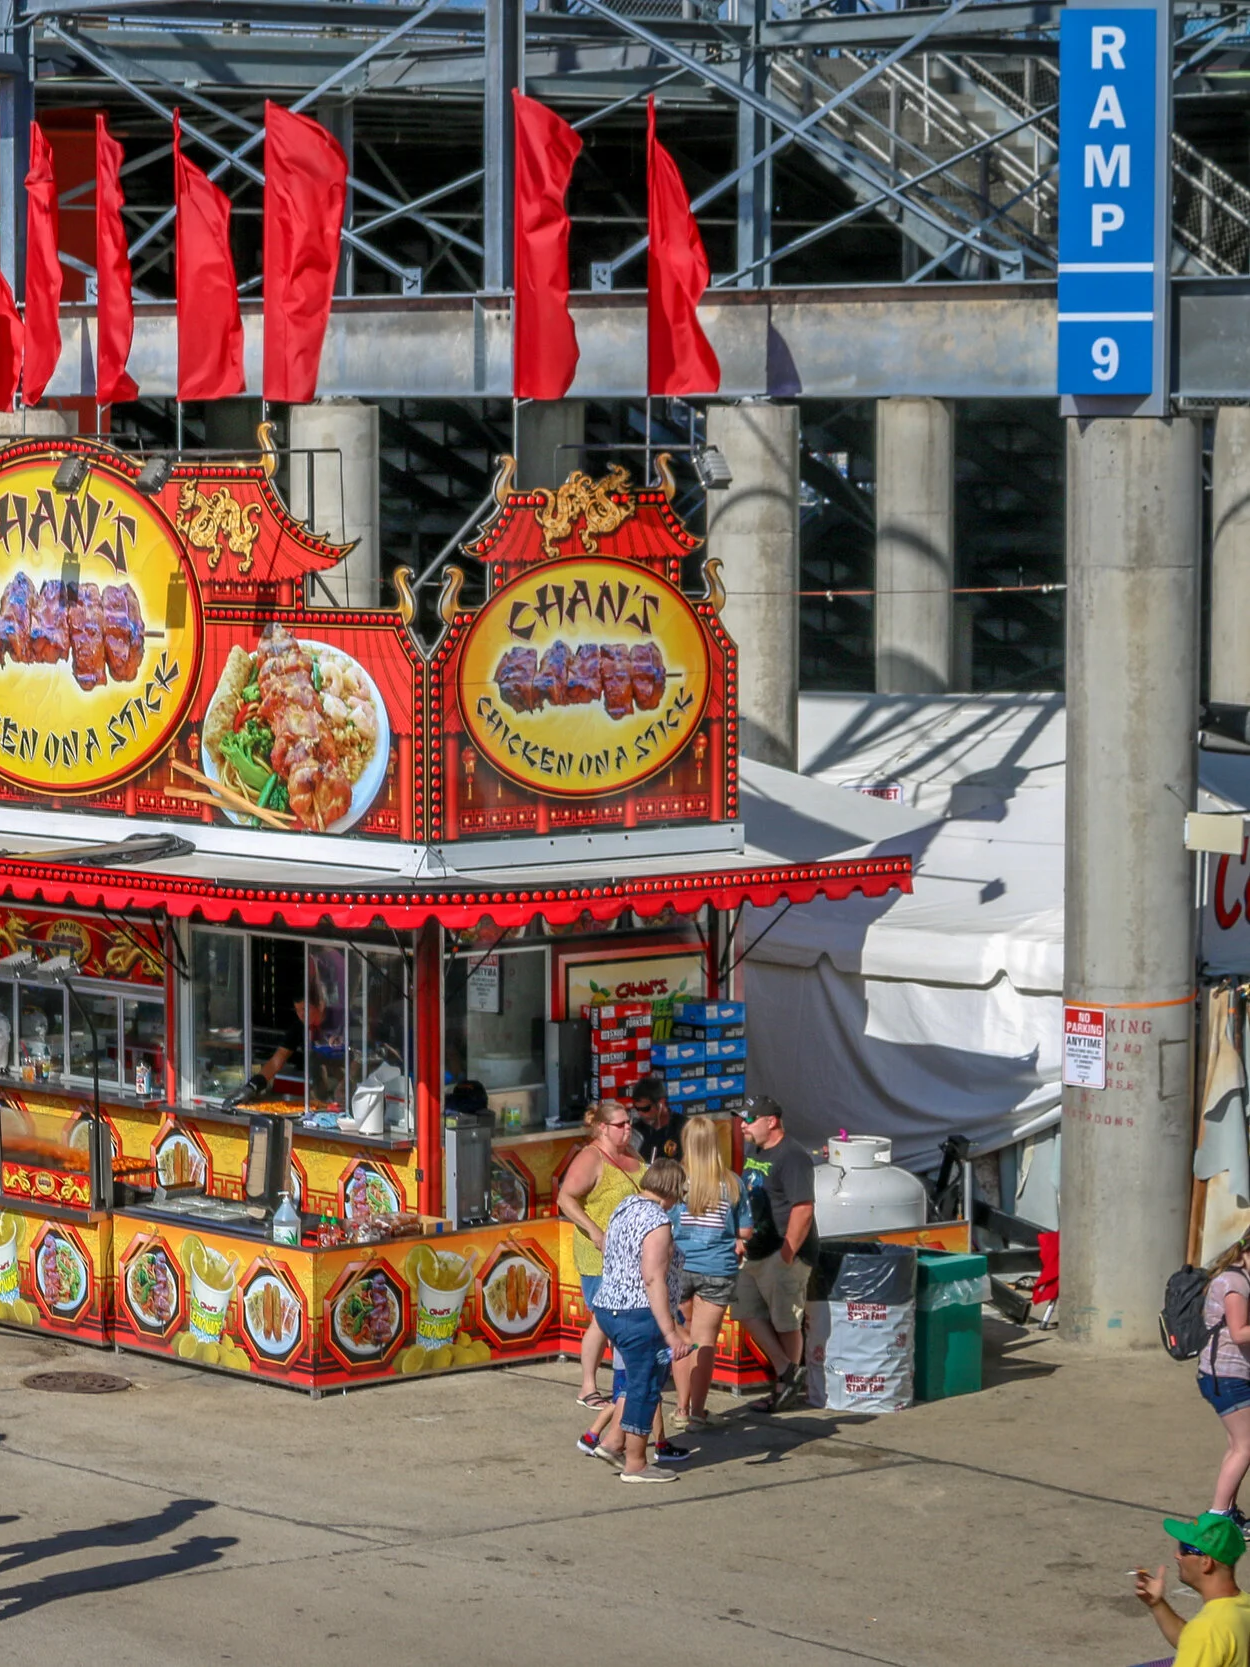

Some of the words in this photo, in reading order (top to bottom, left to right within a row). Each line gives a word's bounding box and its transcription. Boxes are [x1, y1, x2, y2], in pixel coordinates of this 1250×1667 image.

[1084, 25, 1130, 247] RAMP
[1091, 336, 1119, 382] 9
[506, 579, 660, 641] CHAN'S
[107, 650, 180, 759] STICK
[476, 696, 574, 776] CHICKEN
[634, 686, 695, 763] STICK
[1066, 1022, 1102, 1036] PARKING
[1078, 1012, 1090, 1023] NO
[1107, 1018, 1153, 1034] KING
[1066, 1036, 1102, 1049] ANYTIME
